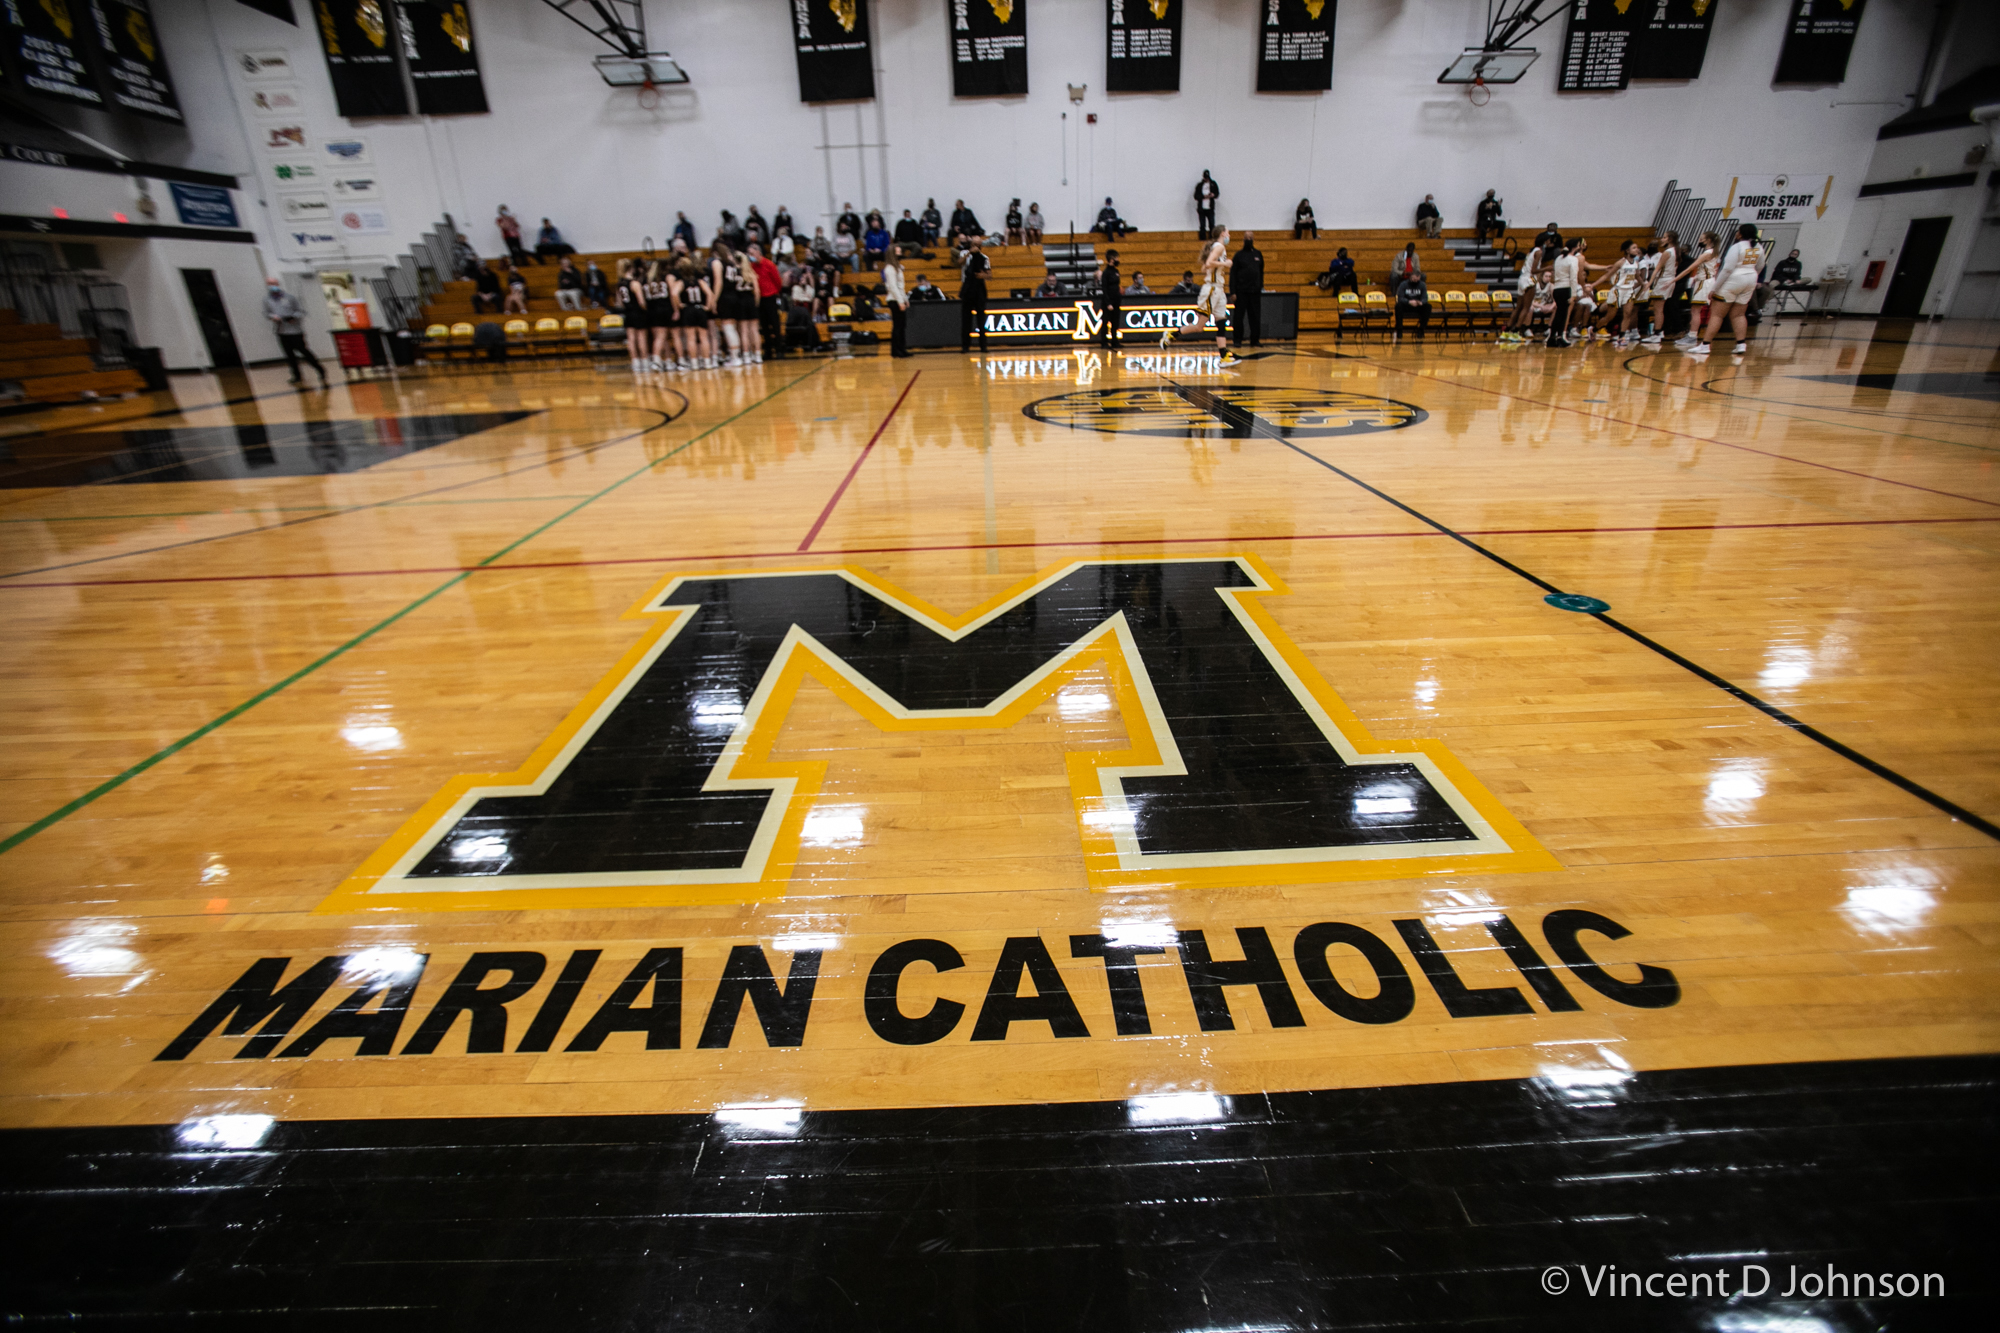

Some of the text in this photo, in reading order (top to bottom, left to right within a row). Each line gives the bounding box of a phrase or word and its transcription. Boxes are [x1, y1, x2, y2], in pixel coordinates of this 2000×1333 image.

[1738, 195, 1814, 207] TOURS START
[1756, 208, 1788, 220] HERE
[1742, 248, 1760, 265] 55
[318, 554, 1556, 912] M
[153, 909, 1682, 1061] MARIAN CATHOLIC
